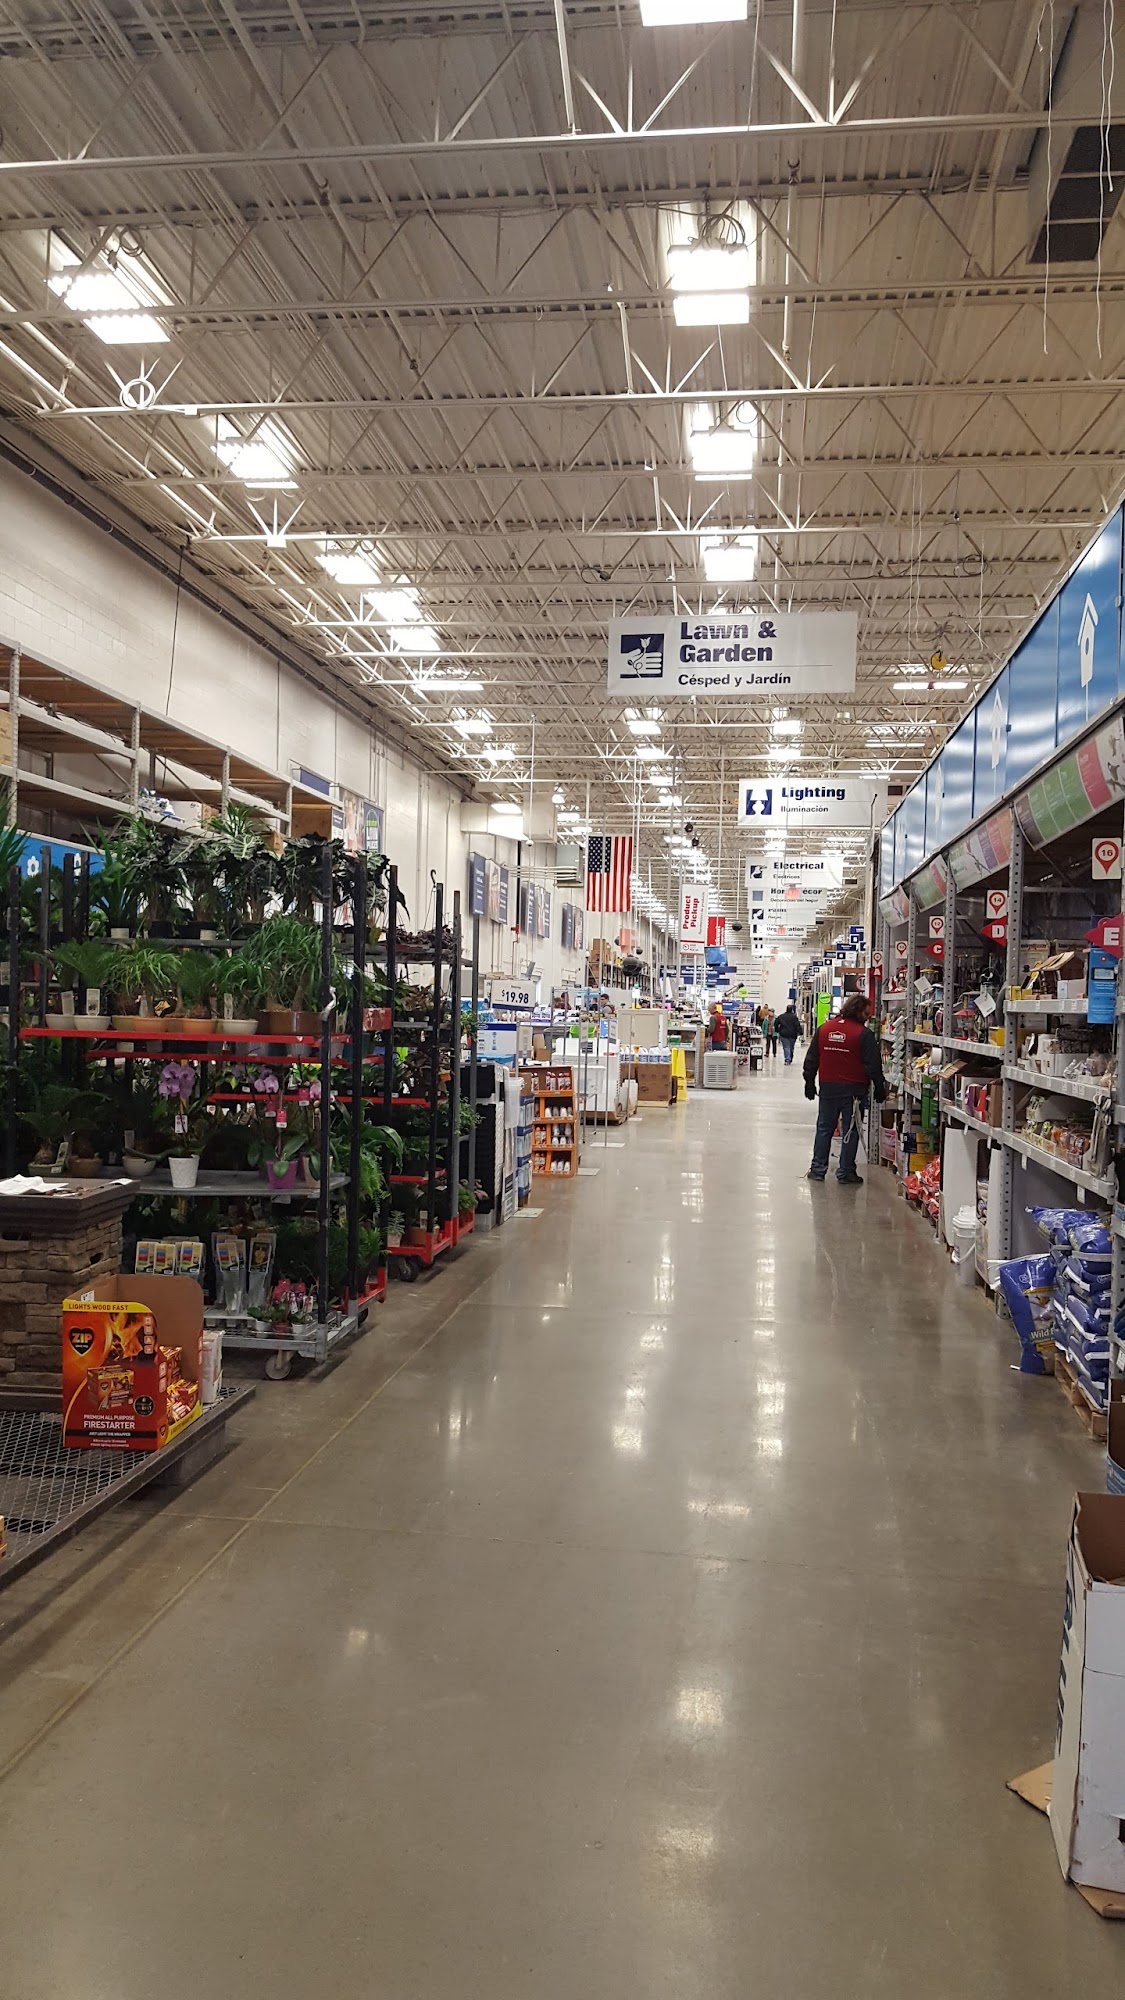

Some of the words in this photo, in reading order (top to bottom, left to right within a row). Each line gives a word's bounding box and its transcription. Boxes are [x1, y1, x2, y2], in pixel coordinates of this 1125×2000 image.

[680, 621, 749, 640] Lawn
[757, 620, 777, 639] &
[679, 643, 773, 663] Garden
[678, 674, 731, 688] Césped
[734, 676, 743, 687] y
[746, 672, 791, 685] Jardín
[781, 786, 846, 801] Lighting
[1101, 849, 1113, 857] 16
[773, 861, 824, 870] Electrical
[682, 895, 692, 929] Product
[690, 898, 700, 927] Pickup
[1103, 927, 1120, 946] E
[933, 944, 942, 954] C
[501, 989, 529, 1004] $19.98
[71, 1333, 93, 1344] ZIP
[1031, 1328, 1049, 1340] Wild
[83, 1420, 135, 1429] FIRESTARTER
